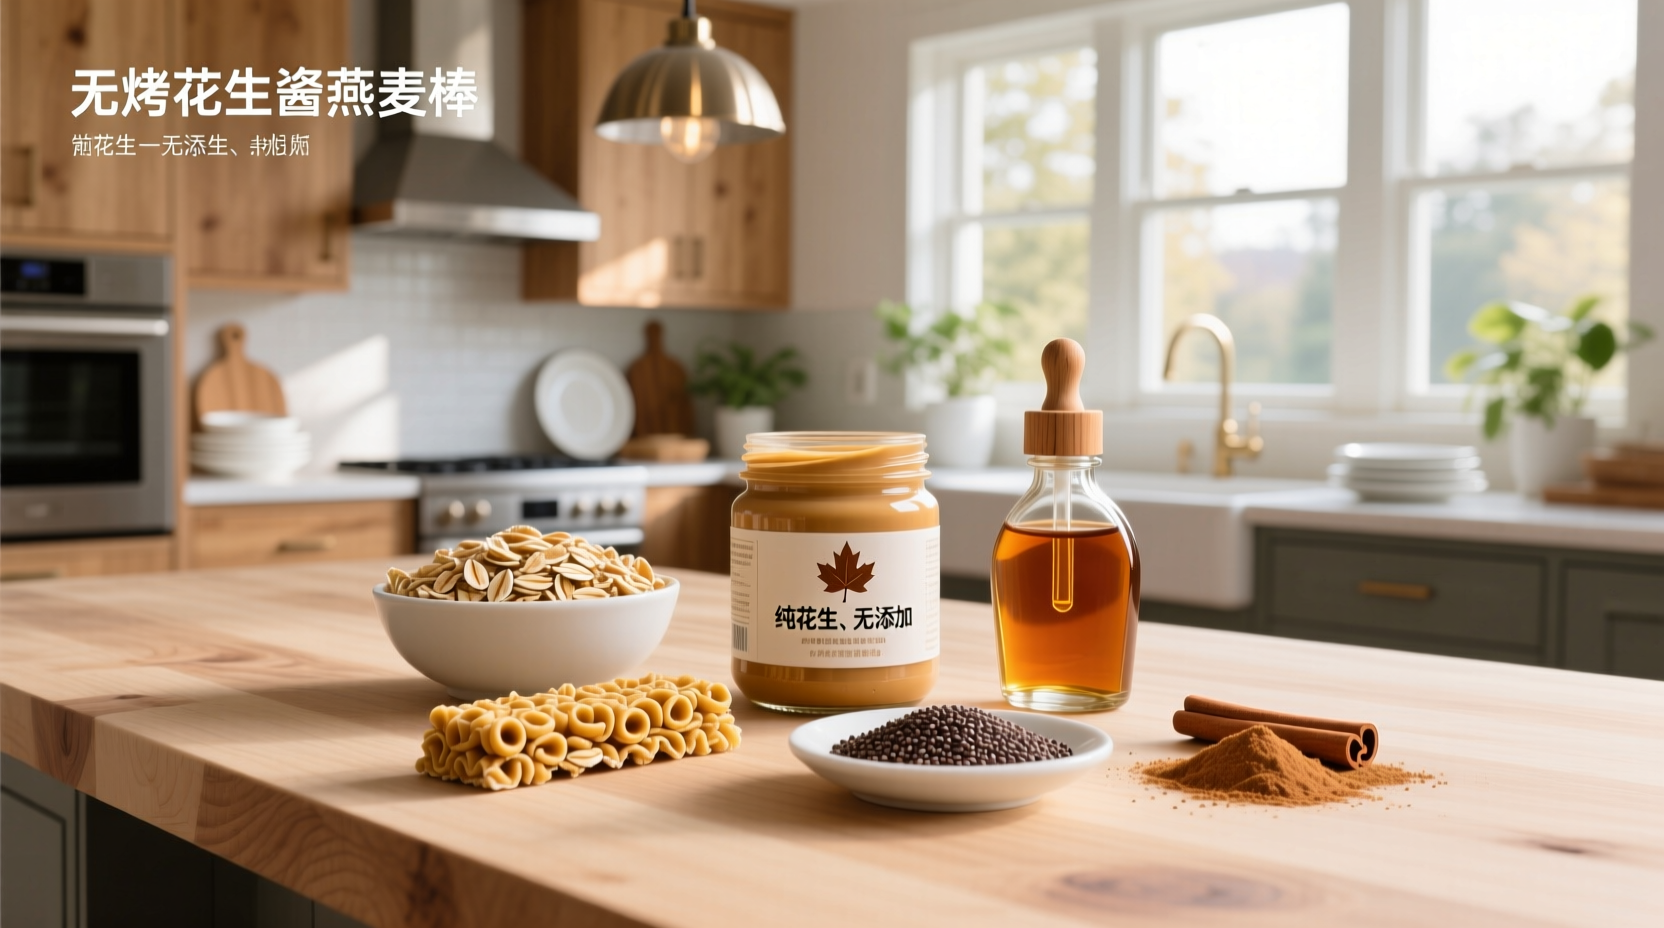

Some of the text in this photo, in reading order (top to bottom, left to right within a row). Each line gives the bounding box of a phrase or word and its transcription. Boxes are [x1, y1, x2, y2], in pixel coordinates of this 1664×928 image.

[774, 604, 913, 631] 纯花生、无添加
